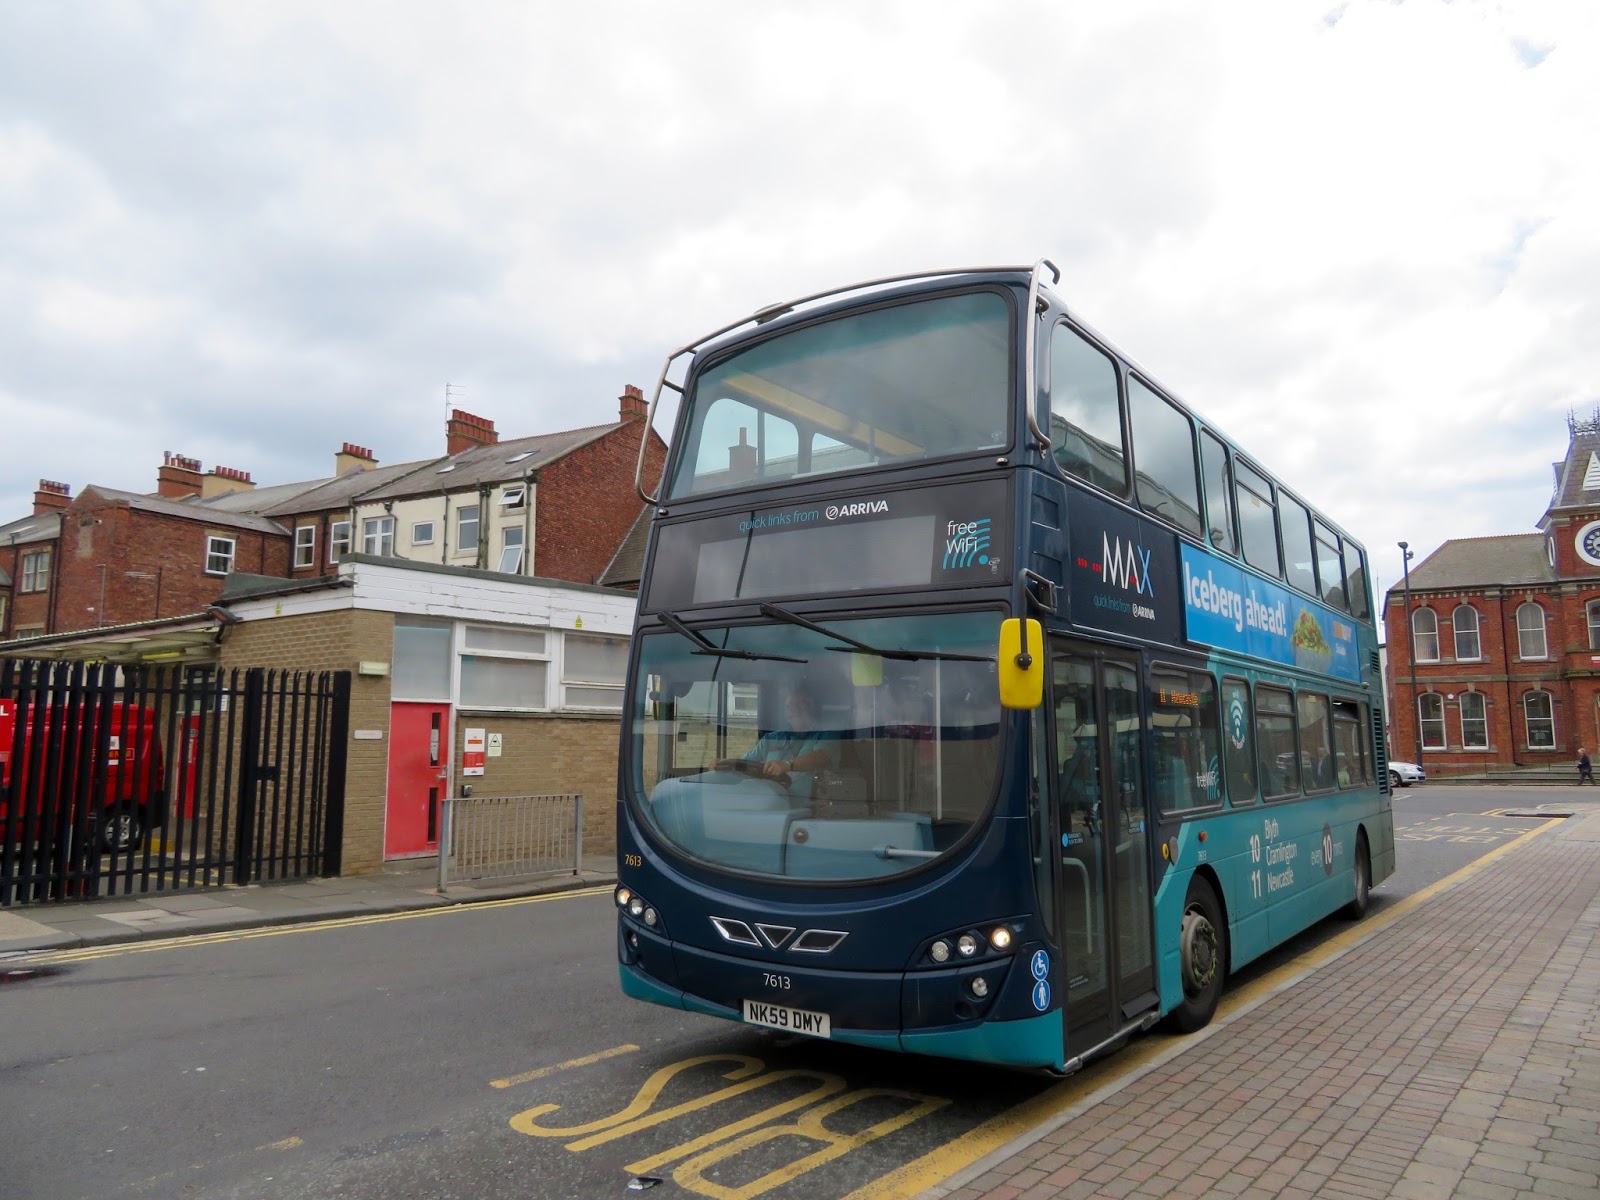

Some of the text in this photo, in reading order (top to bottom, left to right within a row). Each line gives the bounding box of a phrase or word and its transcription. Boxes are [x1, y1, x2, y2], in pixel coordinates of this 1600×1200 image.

[739, 500, 889, 533] quick links from ARRIVA
[947, 520, 977, 536] free
[946, 536, 978, 554] WiFi
[1103, 530, 1154, 598] MAX
[1138, 605, 1156, 620] ARRIVA
[1185, 561, 1287, 637] Iceberg ahead!
[1264, 818, 1279, 843] Blyth
[625, 854, 641, 867] 7613
[1250, 834, 1261, 863] 10
[1266, 842, 1298, 866] Cramlington
[1323, 835, 1333, 865] 10
[1252, 870, 1262, 899] 11
[1267, 866, 1294, 893] Newcastle
[763, 972, 791, 989] 7613
[749, 1002, 822, 1033] NK59 DMY
[508, 1054, 954, 1200] BUS
